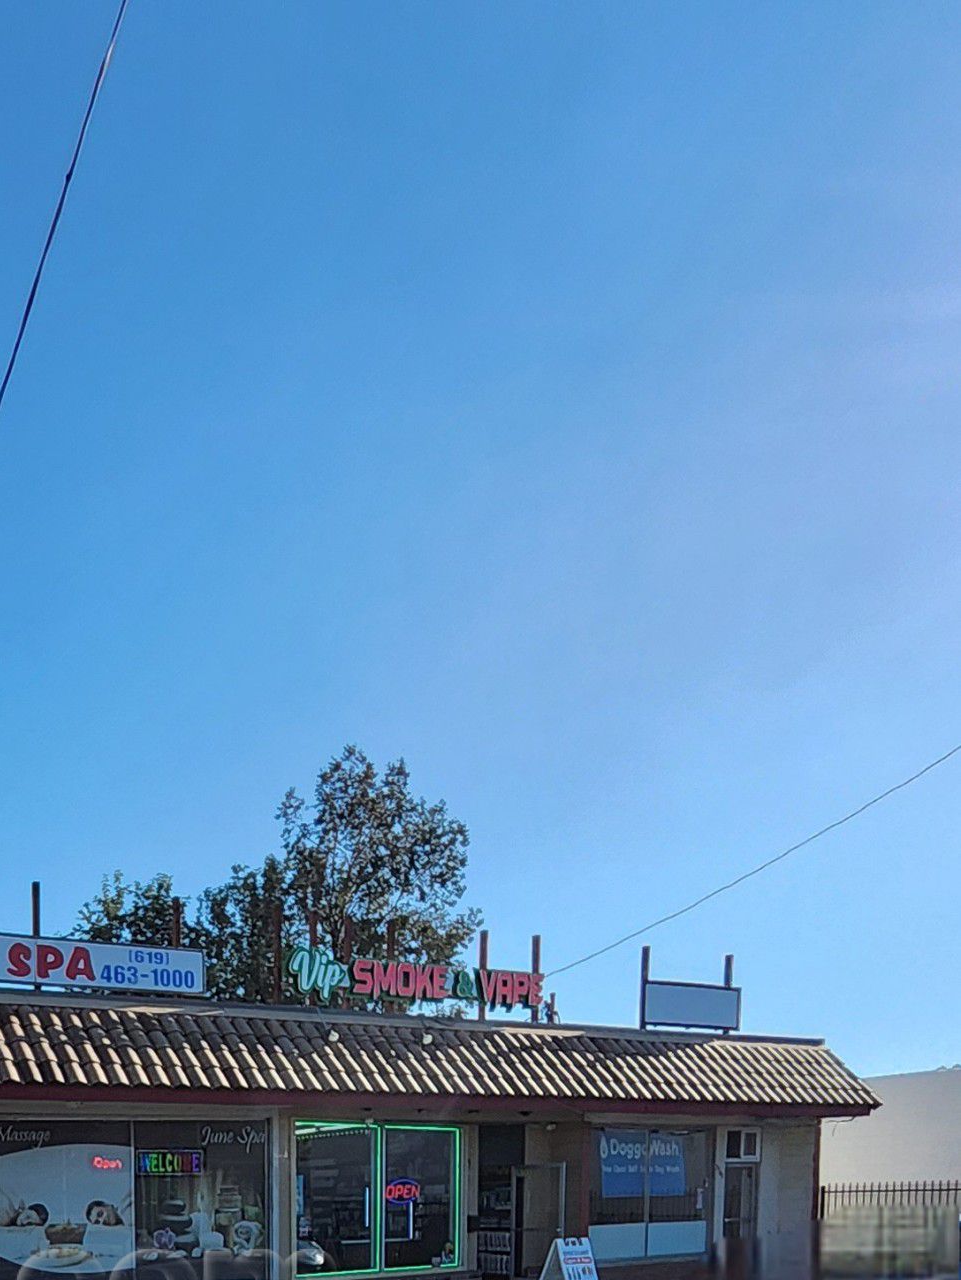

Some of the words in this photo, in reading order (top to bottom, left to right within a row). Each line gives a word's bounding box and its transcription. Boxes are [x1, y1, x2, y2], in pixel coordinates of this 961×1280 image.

[6, 942, 96, 982] SPA
[100, 964, 195, 989] 463-1000
[288, 945, 349, 1001] Vip
[351, 958, 450, 1000] SMOKE
[479, 968, 545, 1009] VAPE
[385, 1184, 421, 1200] OPEN
